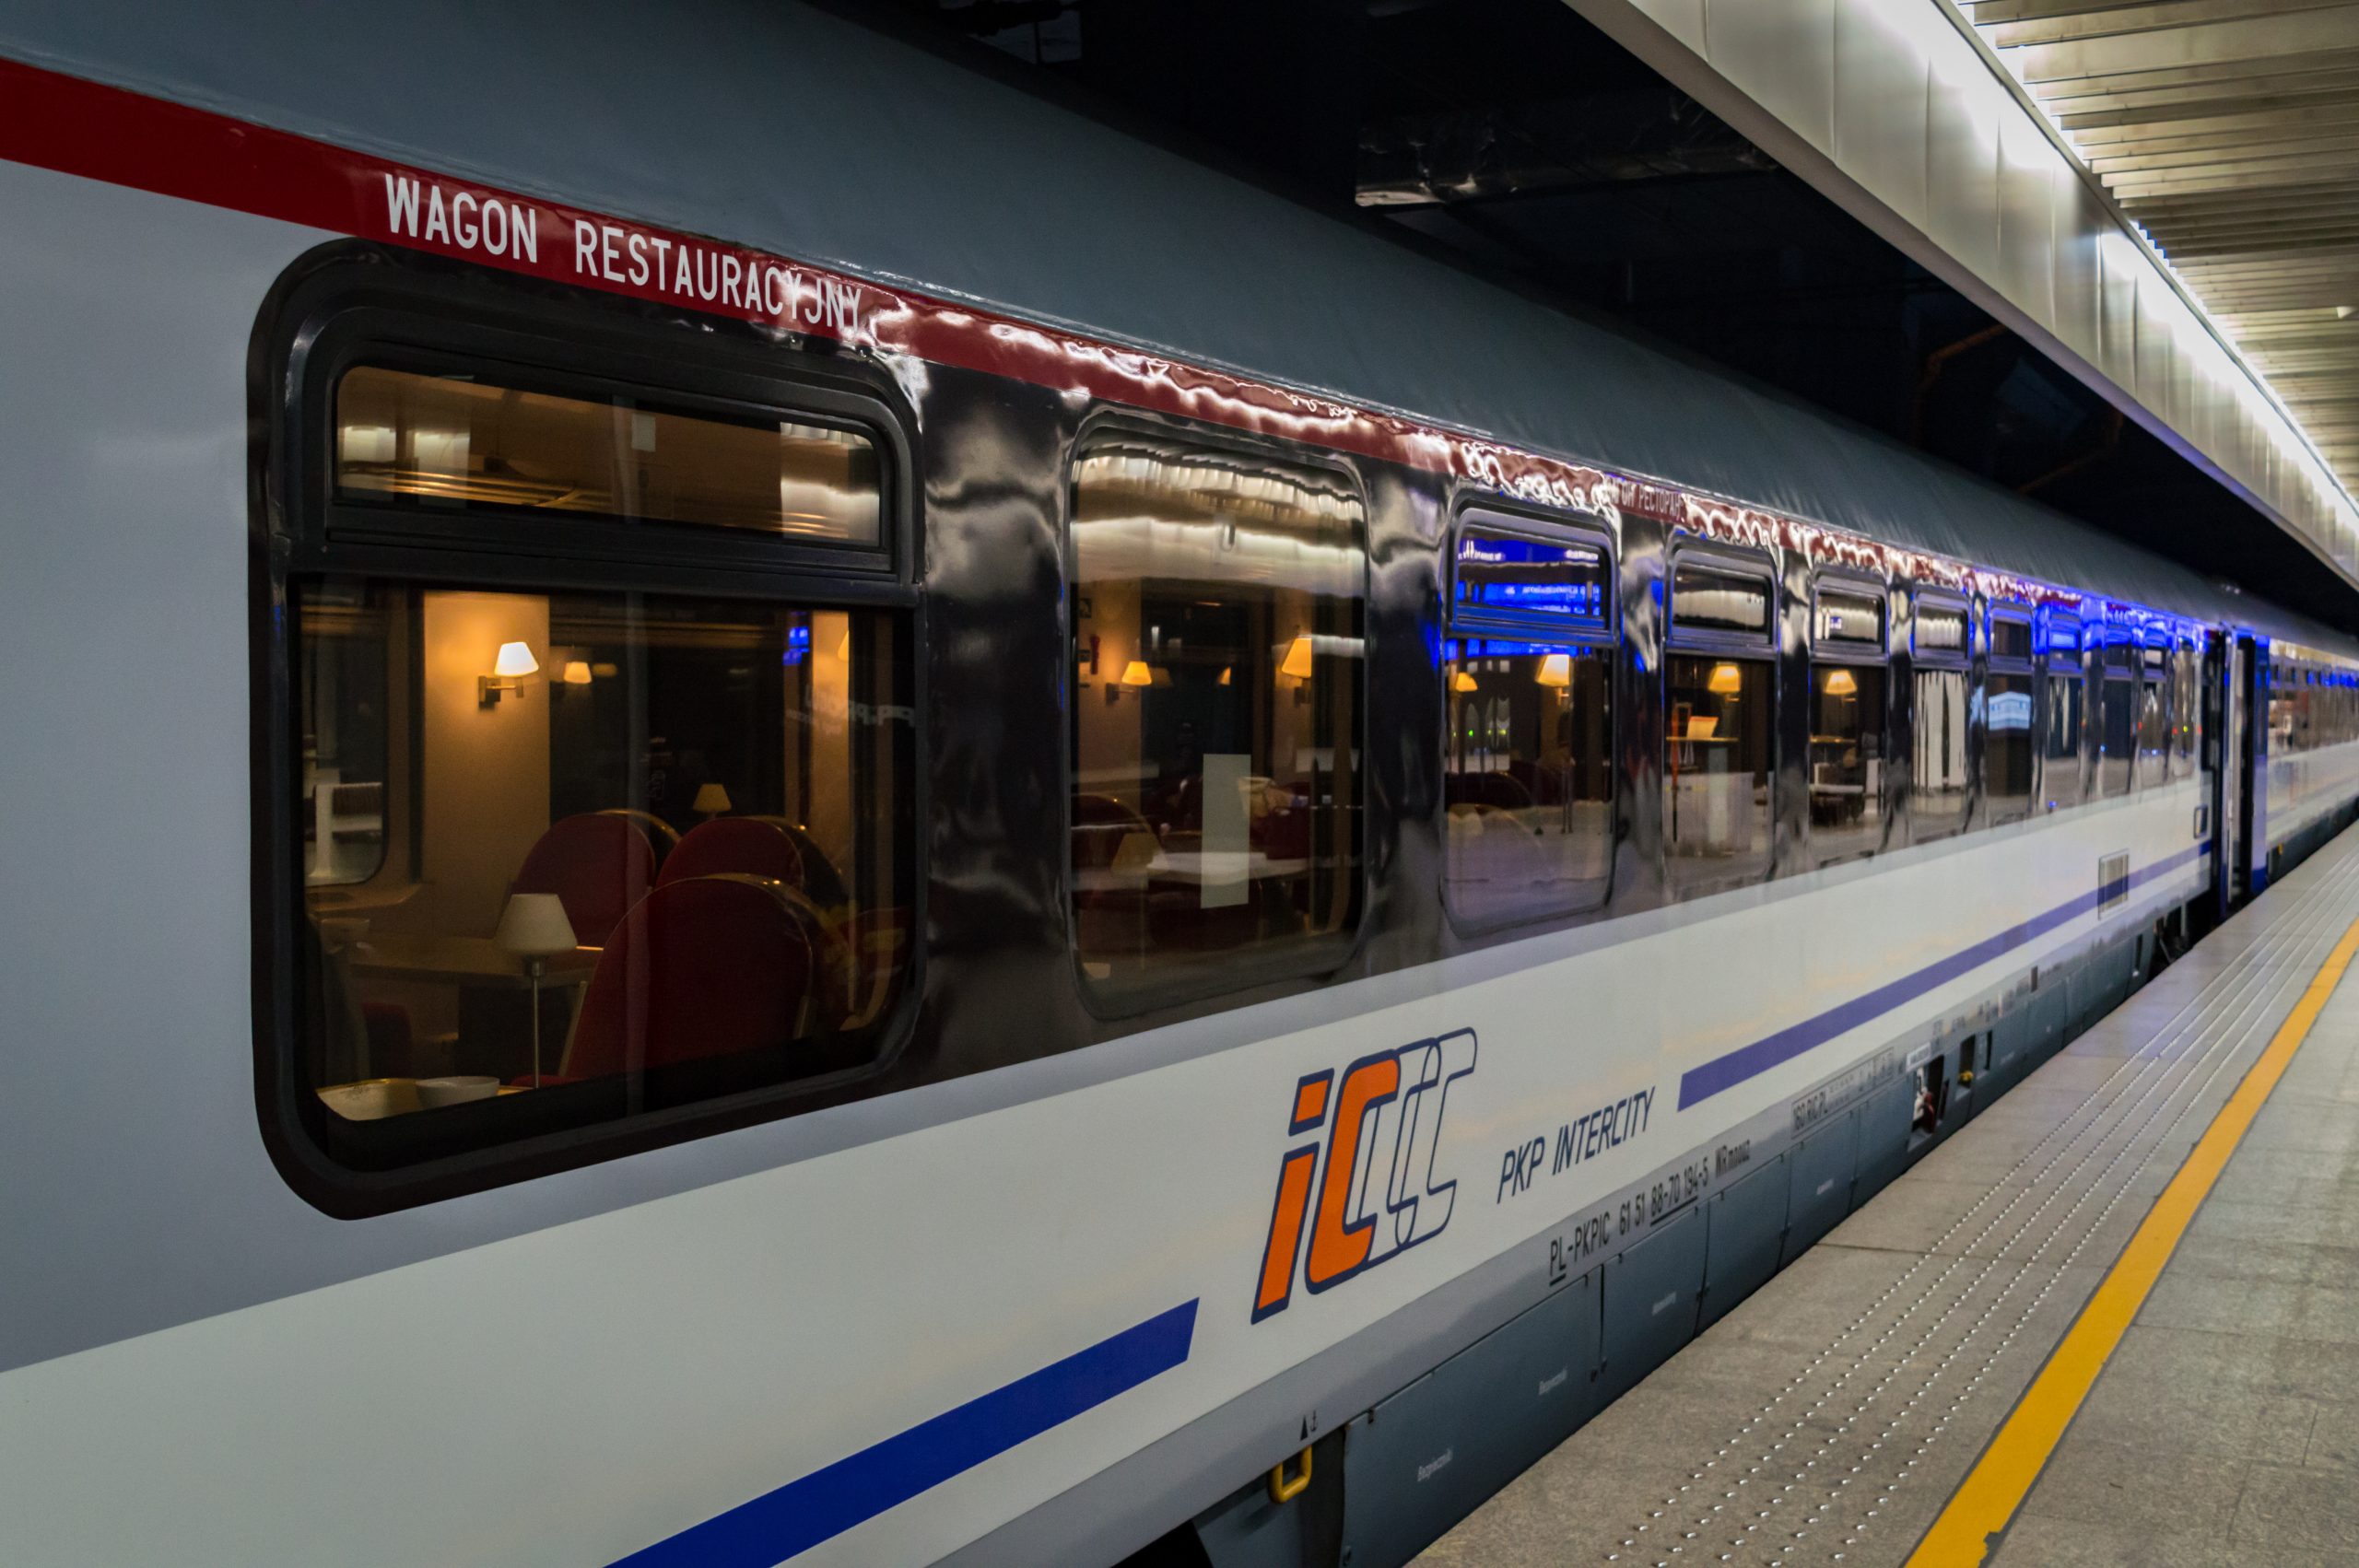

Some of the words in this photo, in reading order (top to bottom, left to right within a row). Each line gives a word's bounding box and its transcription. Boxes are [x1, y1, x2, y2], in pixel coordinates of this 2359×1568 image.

[384, 173, 538, 263] WAGON
[575, 219, 863, 333] RESTAURACYJNY
[1496, 1136, 1545, 1205] PKP
[1552, 1086, 1656, 1176] INTERCITY
[1549, 1211, 1611, 1279] PL-PKPIC
[1619, 1199, 1631, 1235] 61
[1635, 1191, 1646, 1227] 51
[1650, 1172, 1681, 1218] 88-70
